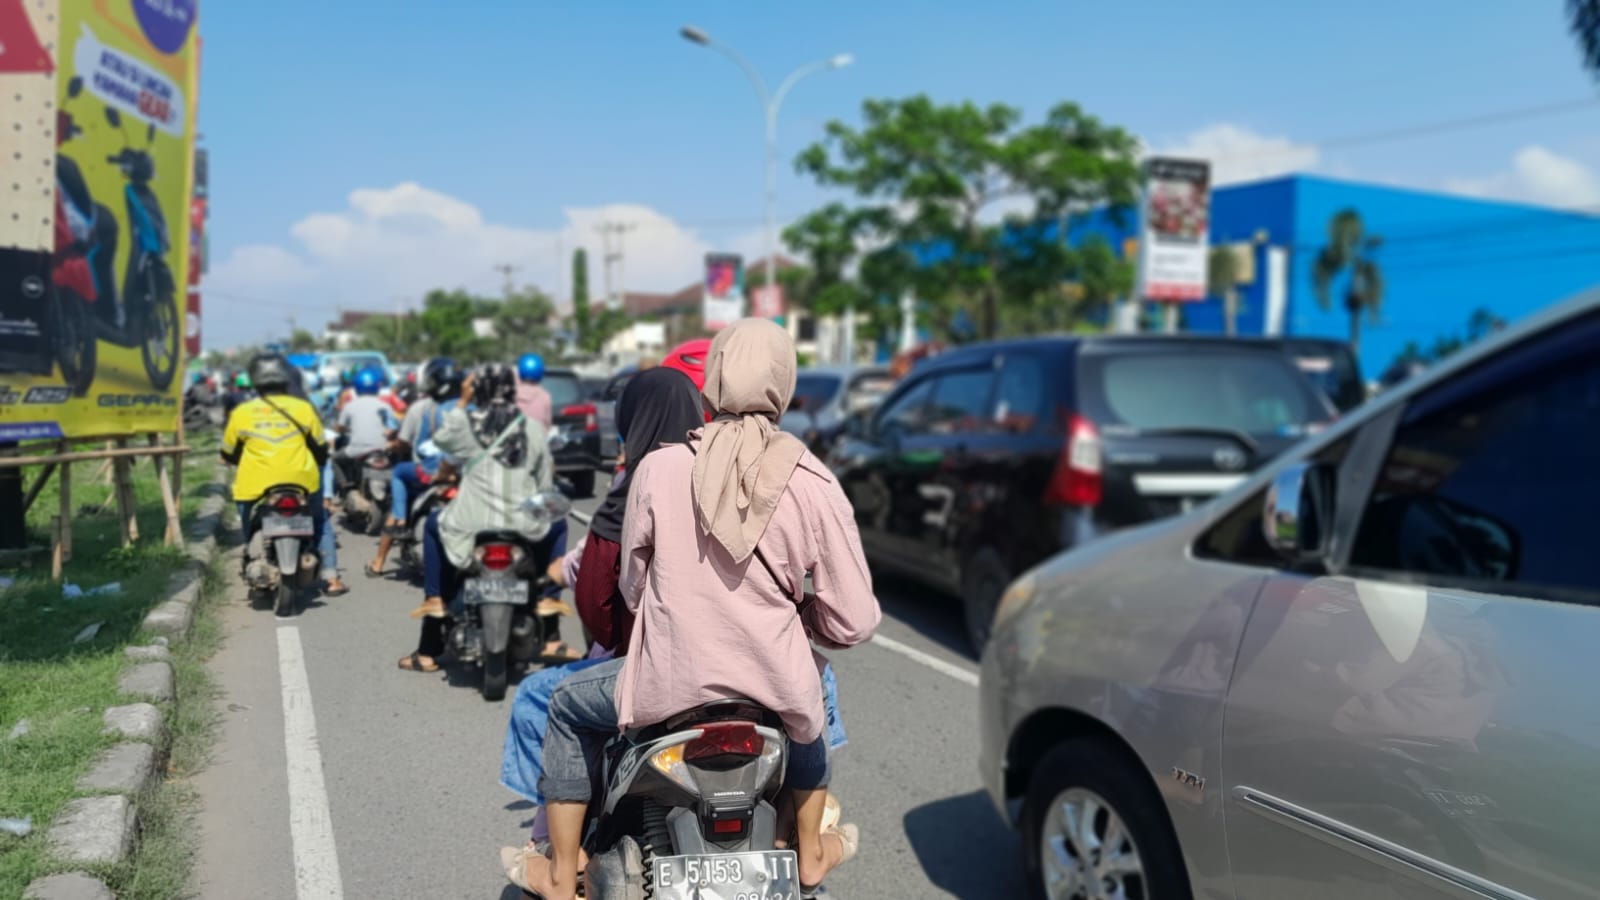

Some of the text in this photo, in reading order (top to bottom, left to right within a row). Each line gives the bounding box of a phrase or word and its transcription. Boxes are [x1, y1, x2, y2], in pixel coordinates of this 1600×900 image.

[659, 856, 794, 887] E 5153 IT
